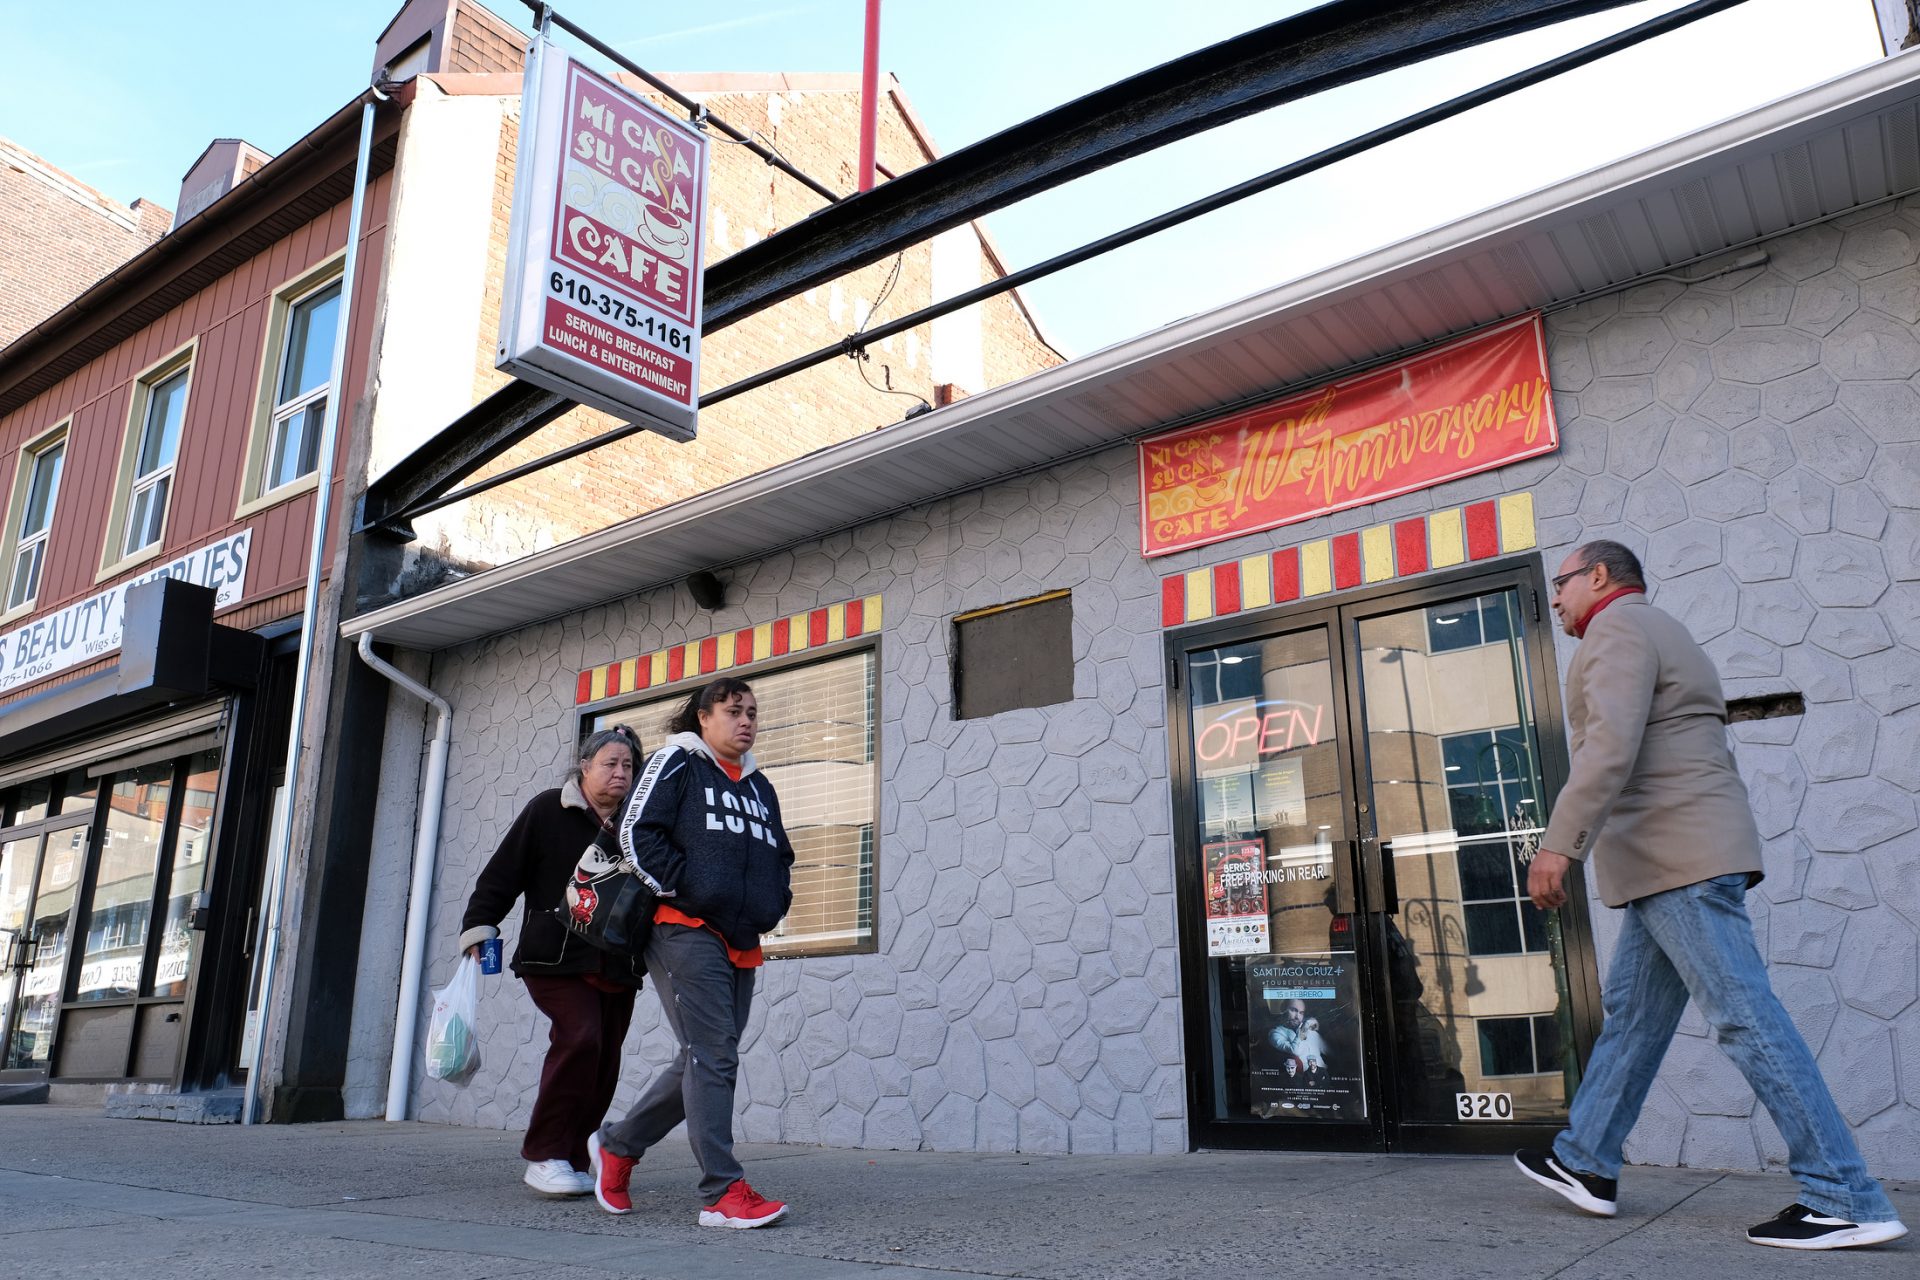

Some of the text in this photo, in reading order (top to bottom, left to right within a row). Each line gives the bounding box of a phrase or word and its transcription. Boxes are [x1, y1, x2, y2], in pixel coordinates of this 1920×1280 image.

[581, 96, 692, 178] MI CASA
[574, 131, 690, 214] SU CASA
[569, 216, 682, 302] CAFE
[550, 271, 691, 353] 610-375-1161
[565, 312, 676, 372] SERVING BREAKFAST
[549, 325, 687, 397] LUNCH & ENTERTAINMENT
[1150, 447, 1171, 468] MI
[1231, 376, 1545, 520] 10th Anniversary
[1152, 467, 1175, 490] SU
[1153, 506, 1229, 543] CAFE
[13, 590, 116, 671] BEAUTY
[0, 632, 120, 687] 75-1066 Wigs &
[1197, 704, 1324, 761] OPEN
[647, 753, 666, 775] QUEEN
[634, 777, 652, 801] QUEEN
[623, 804, 640, 829] QUEEN
[705, 787, 777, 848] LOVE
[621, 831, 632, 859] QUEEN
[1220, 865, 1325, 888] FREE PARKING IN REAR
[1223, 862, 1250, 873] BERKS
[1253, 966, 1334, 977] SANTIAGO CRUZ
[1290, 990, 1324, 998] FEBRERO
[1459, 1094, 1511, 1119] 320
